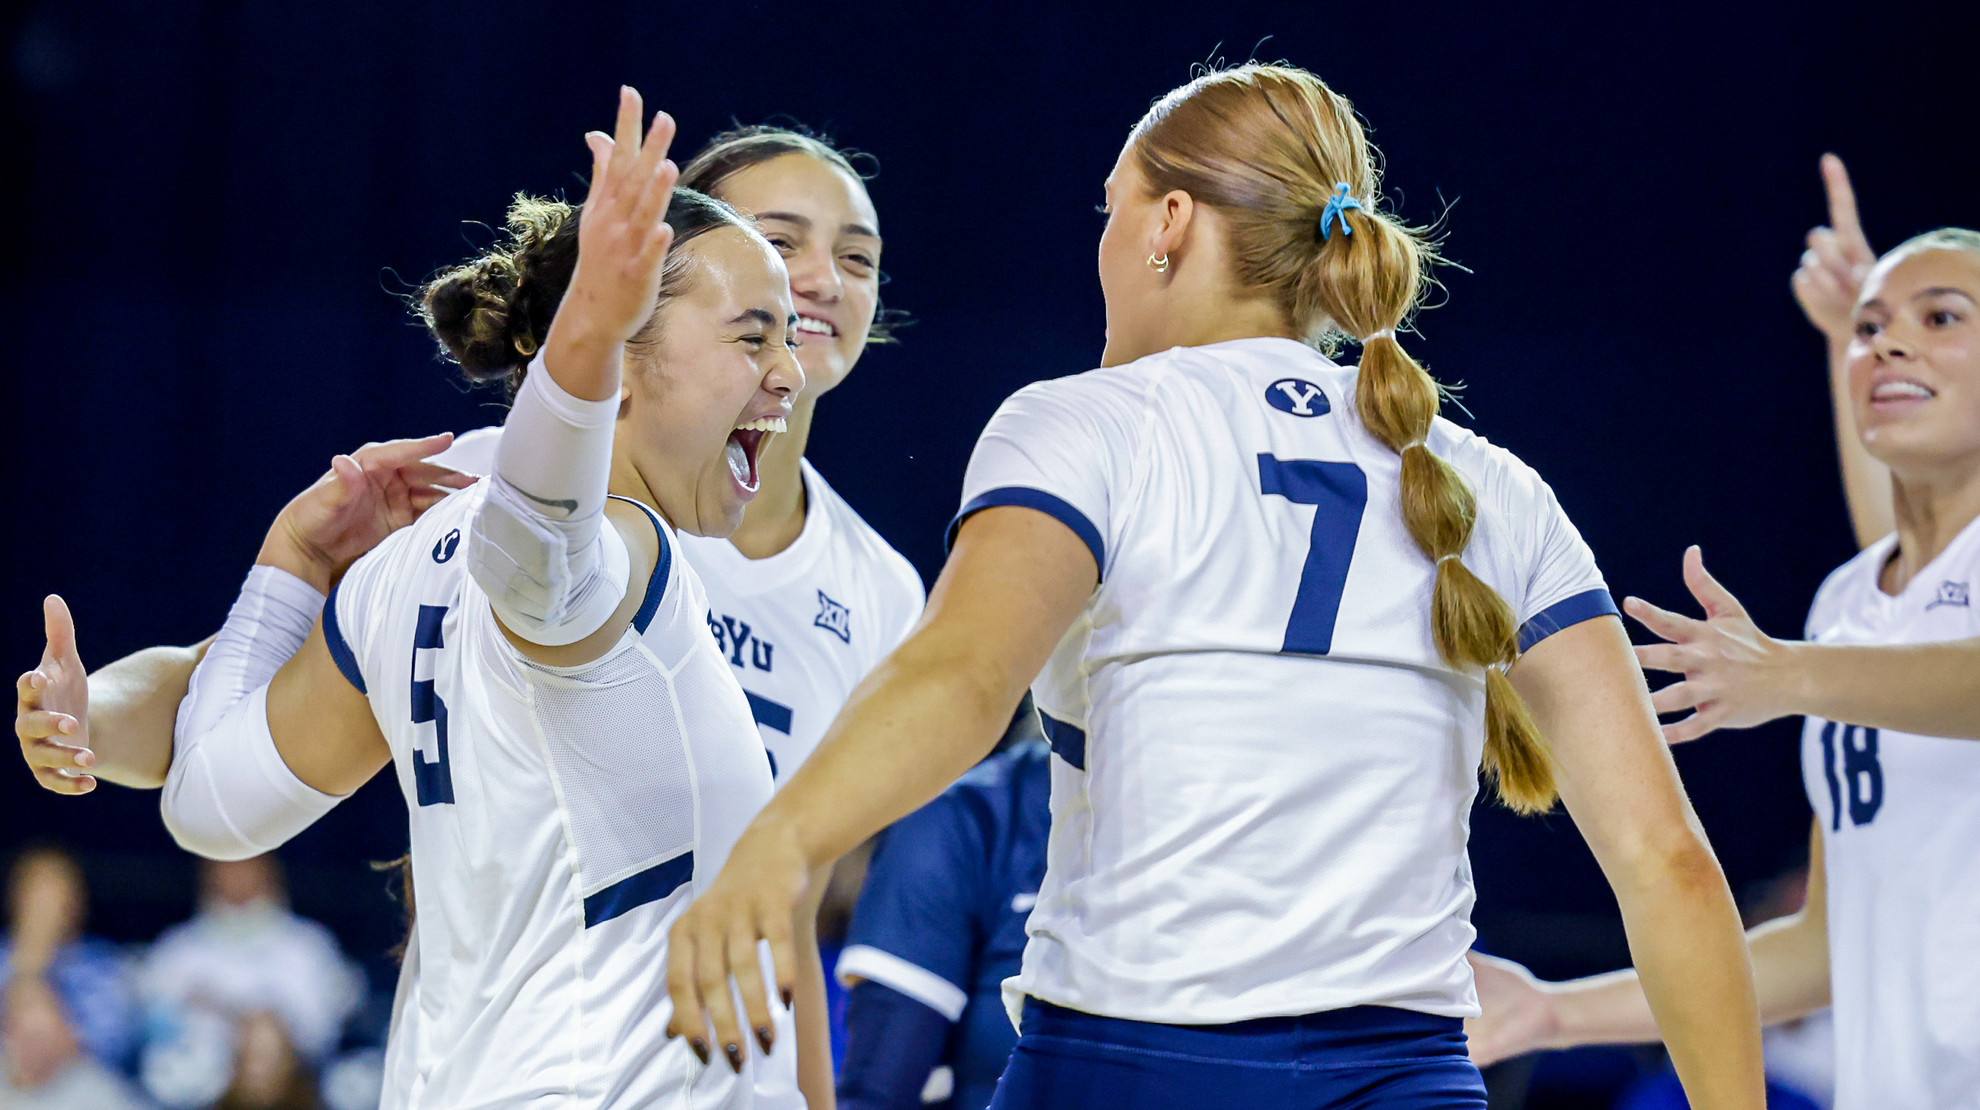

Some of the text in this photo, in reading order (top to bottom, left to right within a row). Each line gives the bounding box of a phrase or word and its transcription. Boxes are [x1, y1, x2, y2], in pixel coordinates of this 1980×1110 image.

[1275, 381, 1321, 415] Y
[1257, 452, 1368, 656] 7
[411, 603, 456, 807] 5
[1821, 721, 1885, 832] 18
